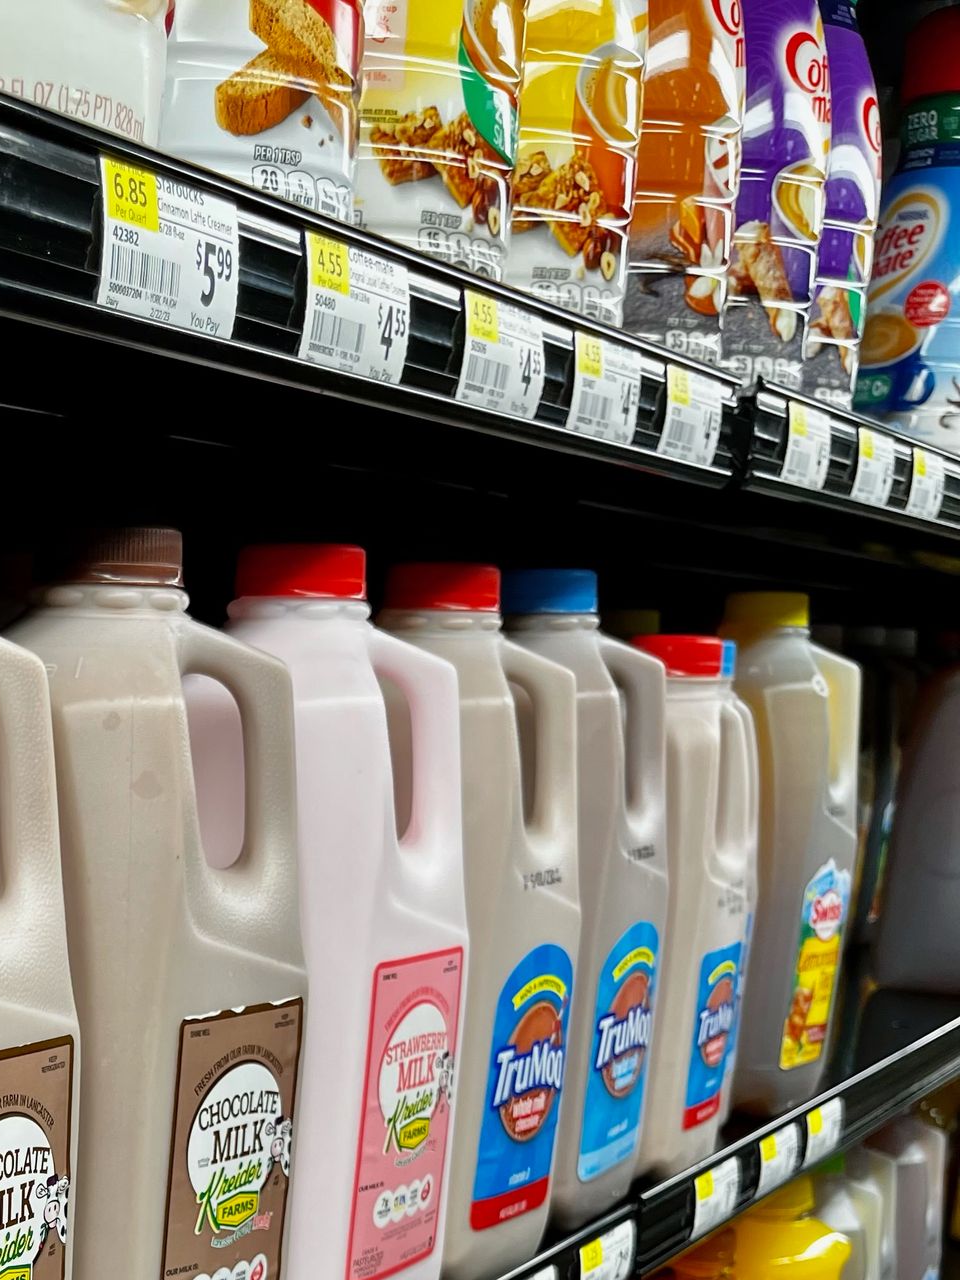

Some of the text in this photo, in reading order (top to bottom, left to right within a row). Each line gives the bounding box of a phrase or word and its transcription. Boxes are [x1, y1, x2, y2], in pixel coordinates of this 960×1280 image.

[58, 85, 90, 118] (1.75
[94, 94, 113, 127] PT)
[114, 103, 133, 134] 828
[907, 110, 938, 130] ZERO
[253, 145, 272, 161] PER
[280, 149, 302, 167] TBSP
[113, 172, 147, 208] 6.85
[261, 169, 278, 191] 20
[157, 196, 233, 236] Cinnamon Latte Creamer
[112, 225, 139, 247] 42382
[317, 249, 343, 278] 4.55
[105, 296, 119, 310] Dairy
[190, 311, 220, 336] You Pay
[385, 1031, 447, 1066] STRAWBERRY
[396, 1053, 436, 1094] MILK
[493, 1043, 564, 1107] TruMoo
[199, 1090, 279, 1131] CHOCOLATE
[210, 1119, 266, 1166] MILK
[403, 1125, 427, 1142] FARMS
[195, 1158, 262, 1235] Kreider
[222, 1199, 254, 1219] FARMS
